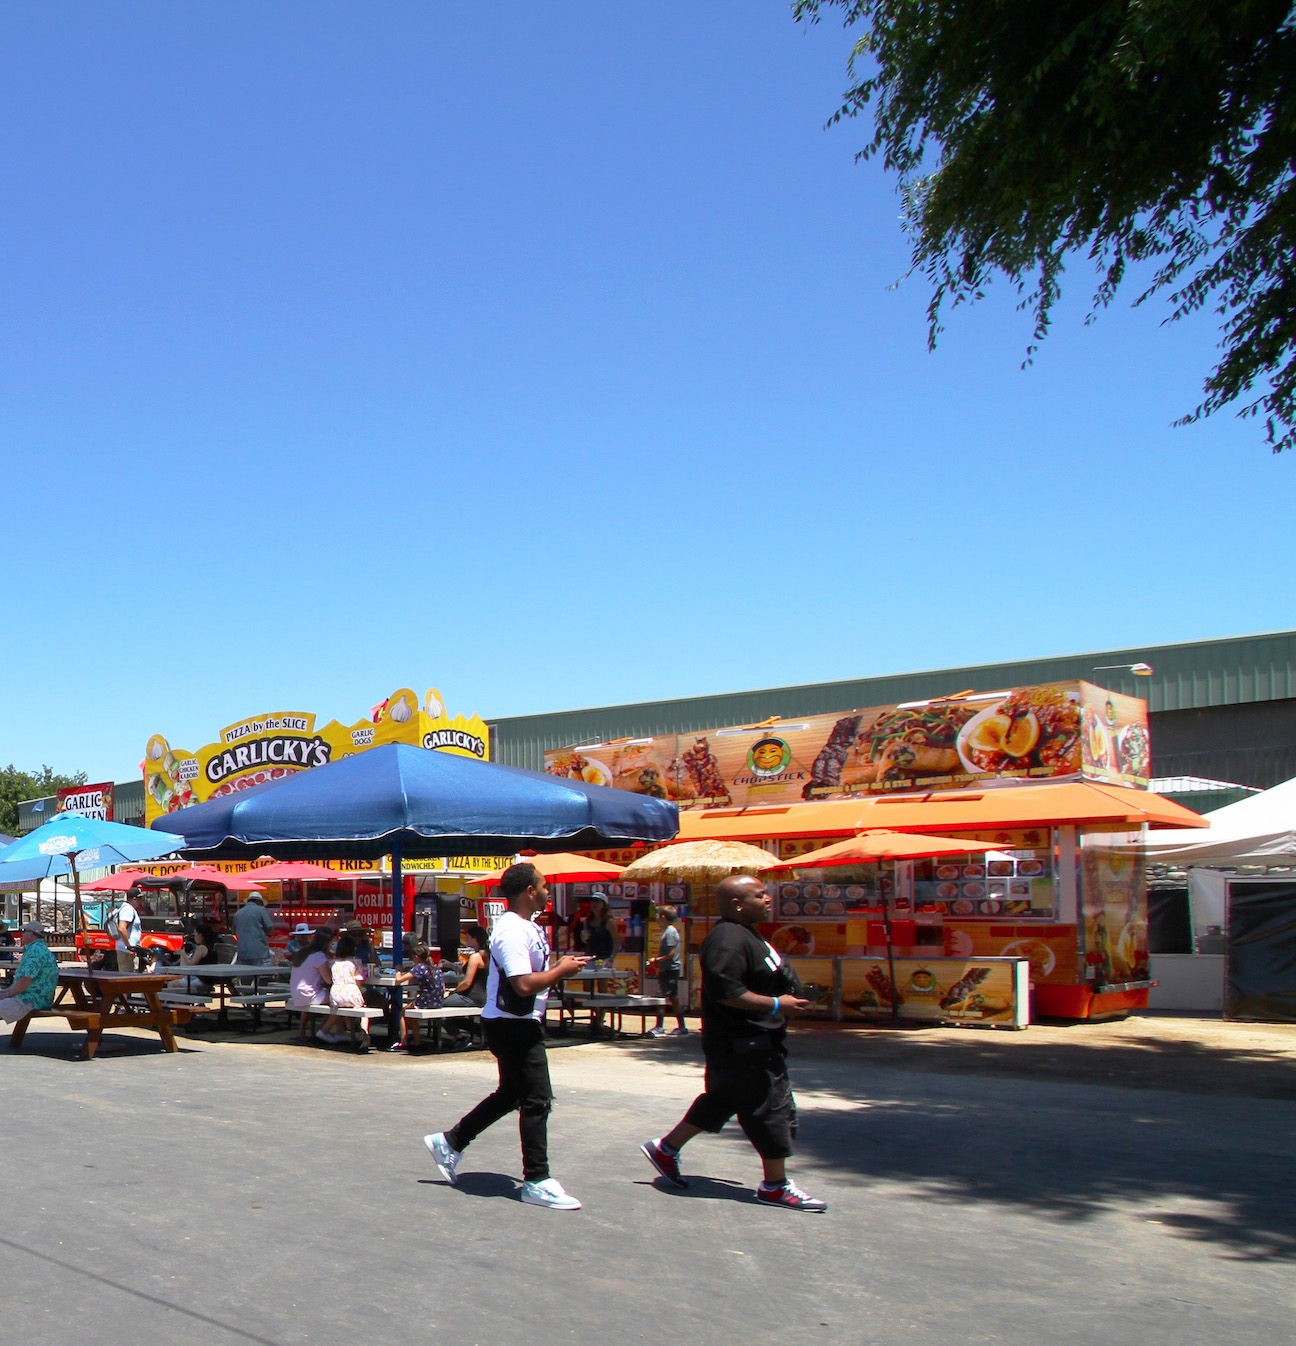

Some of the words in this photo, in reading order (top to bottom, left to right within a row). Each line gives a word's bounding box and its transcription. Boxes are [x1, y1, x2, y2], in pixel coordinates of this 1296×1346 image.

[225, 725, 251, 742] PIZZA
[253, 721, 264, 732] by
[266, 719, 280, 729] the
[282, 718, 307, 730] SLICE
[351, 729, 374, 738] GARLIC
[354, 737, 372, 746] DOGS
[423, 730, 485, 757] GARLICKY'S
[180, 759, 197, 767] GARLIC
[207, 737, 329, 780] GARLICKY'S
[179, 766, 199, 774] CHICKEN
[733, 771, 805, 786] CHOPSTICK
[65, 793, 101, 811] GARLIC
[235, 864, 247, 873] THE
[340, 859, 373, 871] FRIES
[448, 856, 471, 869] PIZZA
[473, 857, 482, 868] BY
[482, 858, 492, 868] THE
[484, 902, 505, 917] PIZZA
